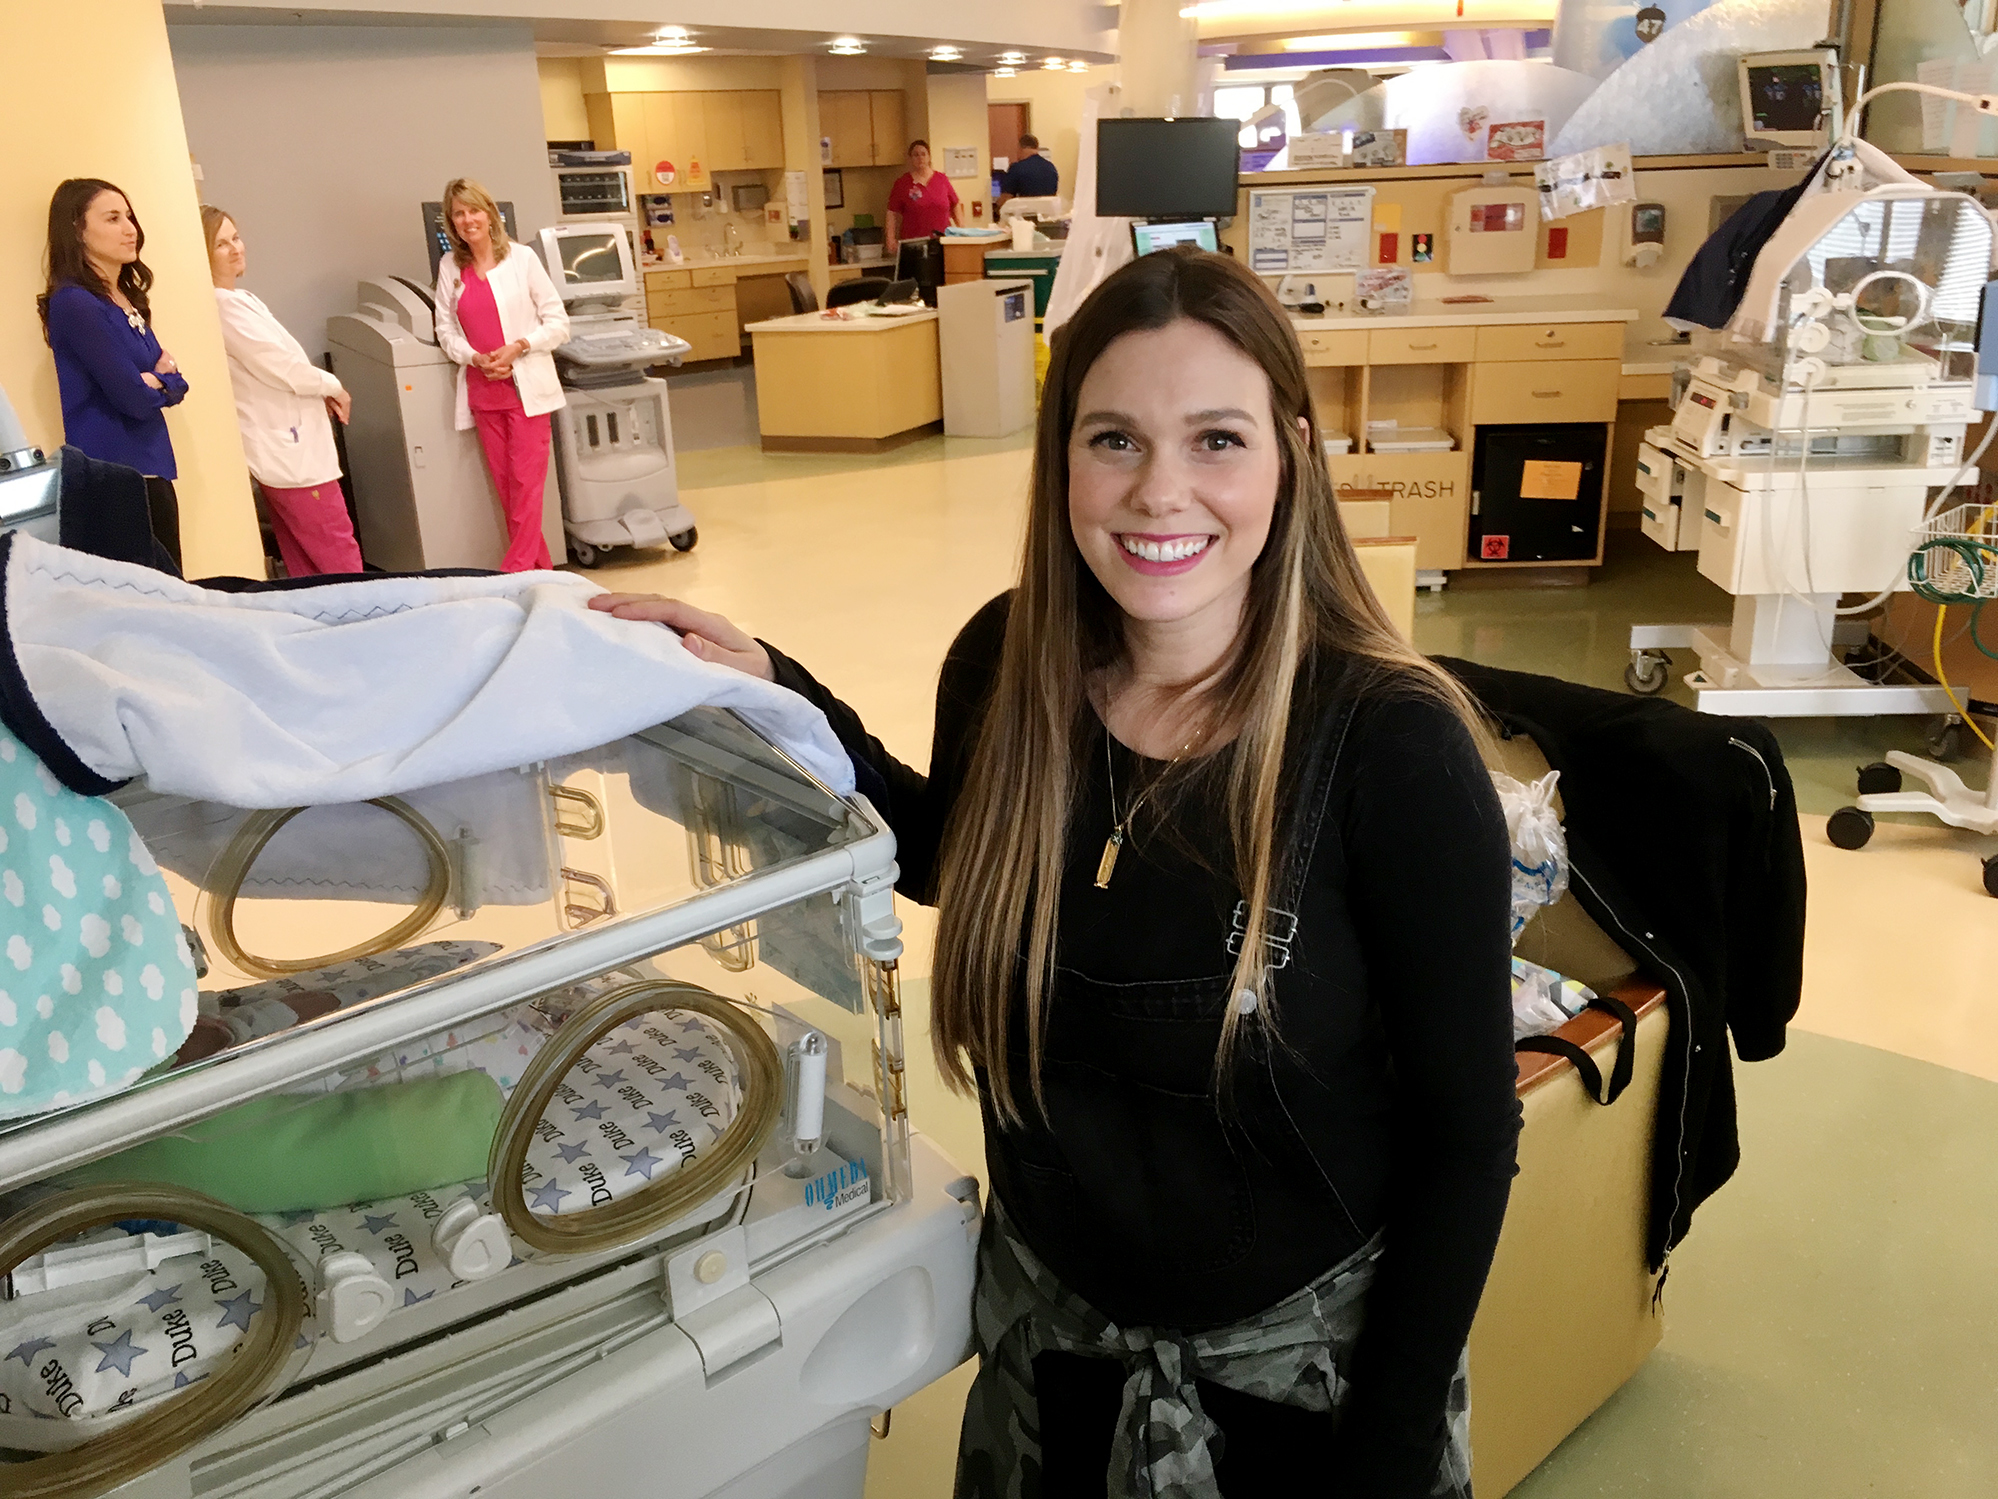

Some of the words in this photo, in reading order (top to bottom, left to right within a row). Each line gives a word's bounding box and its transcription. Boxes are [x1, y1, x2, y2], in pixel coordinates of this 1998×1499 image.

[1637, 19, 1663, 35] 47
[643, 1026, 677, 1048] Duke
[632, 1053, 668, 1076] Duke
[617, 1084, 654, 1111] Duke
[685, 1091, 721, 1119] Duke
[598, 1120, 635, 1152] Duke
[577, 1161, 614, 1207] Duke
[834, 1180, 870, 1208] Medical
[410, 1192, 444, 1219] Duke
[308, 1223, 345, 1254] Duke
[383, 1233, 419, 1280] Duke
[199, 1258, 238, 1295] Duke
[162, 1308, 198, 1368] Duke
[39, 1358, 84, 1418] Duke
